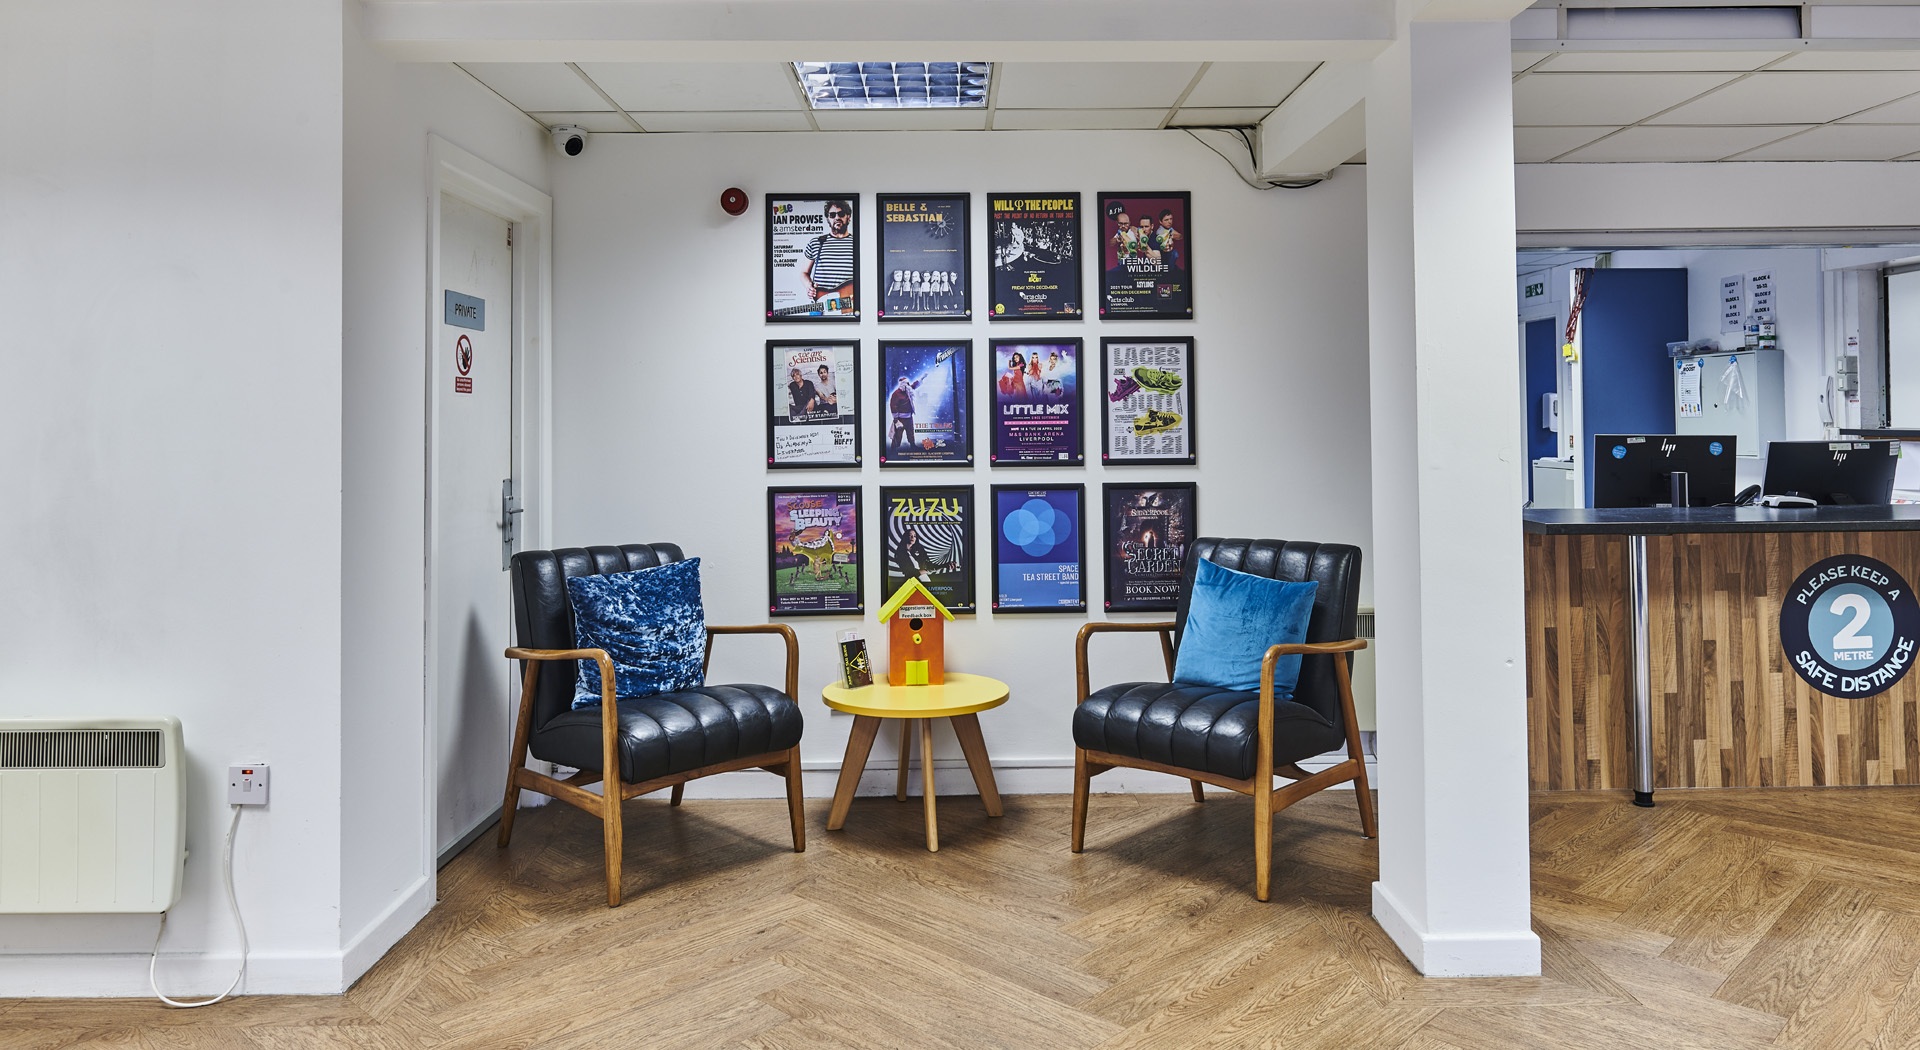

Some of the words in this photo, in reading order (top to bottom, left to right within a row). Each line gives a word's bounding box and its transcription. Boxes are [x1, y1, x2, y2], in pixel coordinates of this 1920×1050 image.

[886, 203, 916, 212] BELLE
[920, 203, 928, 211] &
[994, 200, 1014, 211] WILL
[1025, 200, 1041, 211] THE
[1042, 199, 1074, 210] PEOPLE
[1109, 207, 1122, 215] ASH
[774, 216, 787, 224] IAN
[790, 215, 823, 224] PROWSE
[886, 214, 943, 222] SEBASTIAN
[455, 304, 476, 319] PRIVATE
[789, 355, 827, 367] Scientists
[1114, 347, 1180, 366] LACES
[1004, 405, 1043, 415] LITTLE
[1046, 404, 1069, 414] MIX
[1661, 438, 1676, 457] hp
[1833, 450, 1847, 466] hp
[787, 500, 822, 510] SCOUSE
[892, 498, 958, 516] ZUZU
[790, 508, 839, 520] SLEEPING
[795, 517, 841, 530] BEAUTY
[1122, 541, 1178, 562] SECRET
[1124, 559, 1181, 574] GARDEN
[1796, 565, 1847, 605] PLEASE
[1851, 565, 1889, 586] KEEP
[1888, 589, 1900, 601] A
[1830, 593, 1873, 650] 2
[1834, 651, 1874, 661] METRE
[1795, 651, 1837, 689] SAFE
[1841, 636, 1914, 692] DISTANCE
